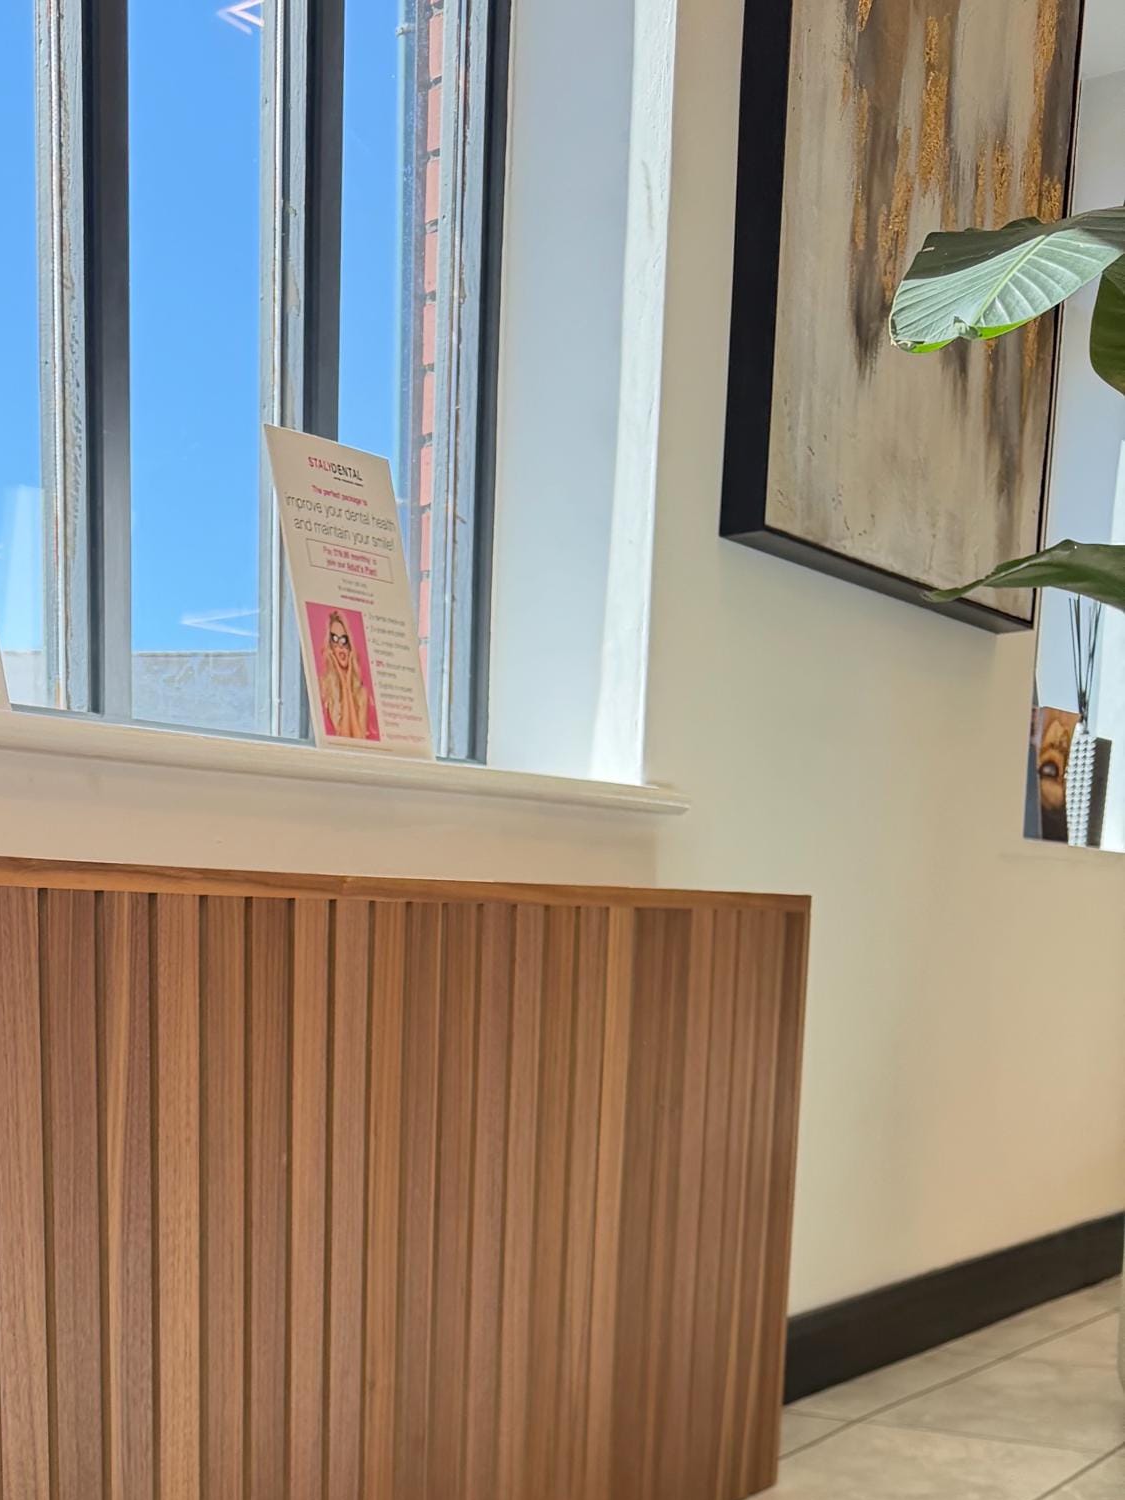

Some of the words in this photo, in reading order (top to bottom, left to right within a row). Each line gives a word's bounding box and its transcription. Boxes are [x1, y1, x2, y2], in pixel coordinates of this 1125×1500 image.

[308, 456, 363, 481] STALYDENTAL
[284, 491, 323, 514] improve
[324, 503, 342, 518] your
[344, 508, 369, 525] dental
[294, 518, 312, 532] and
[314, 521, 350, 539] maintain
[353, 531, 370, 545] your
